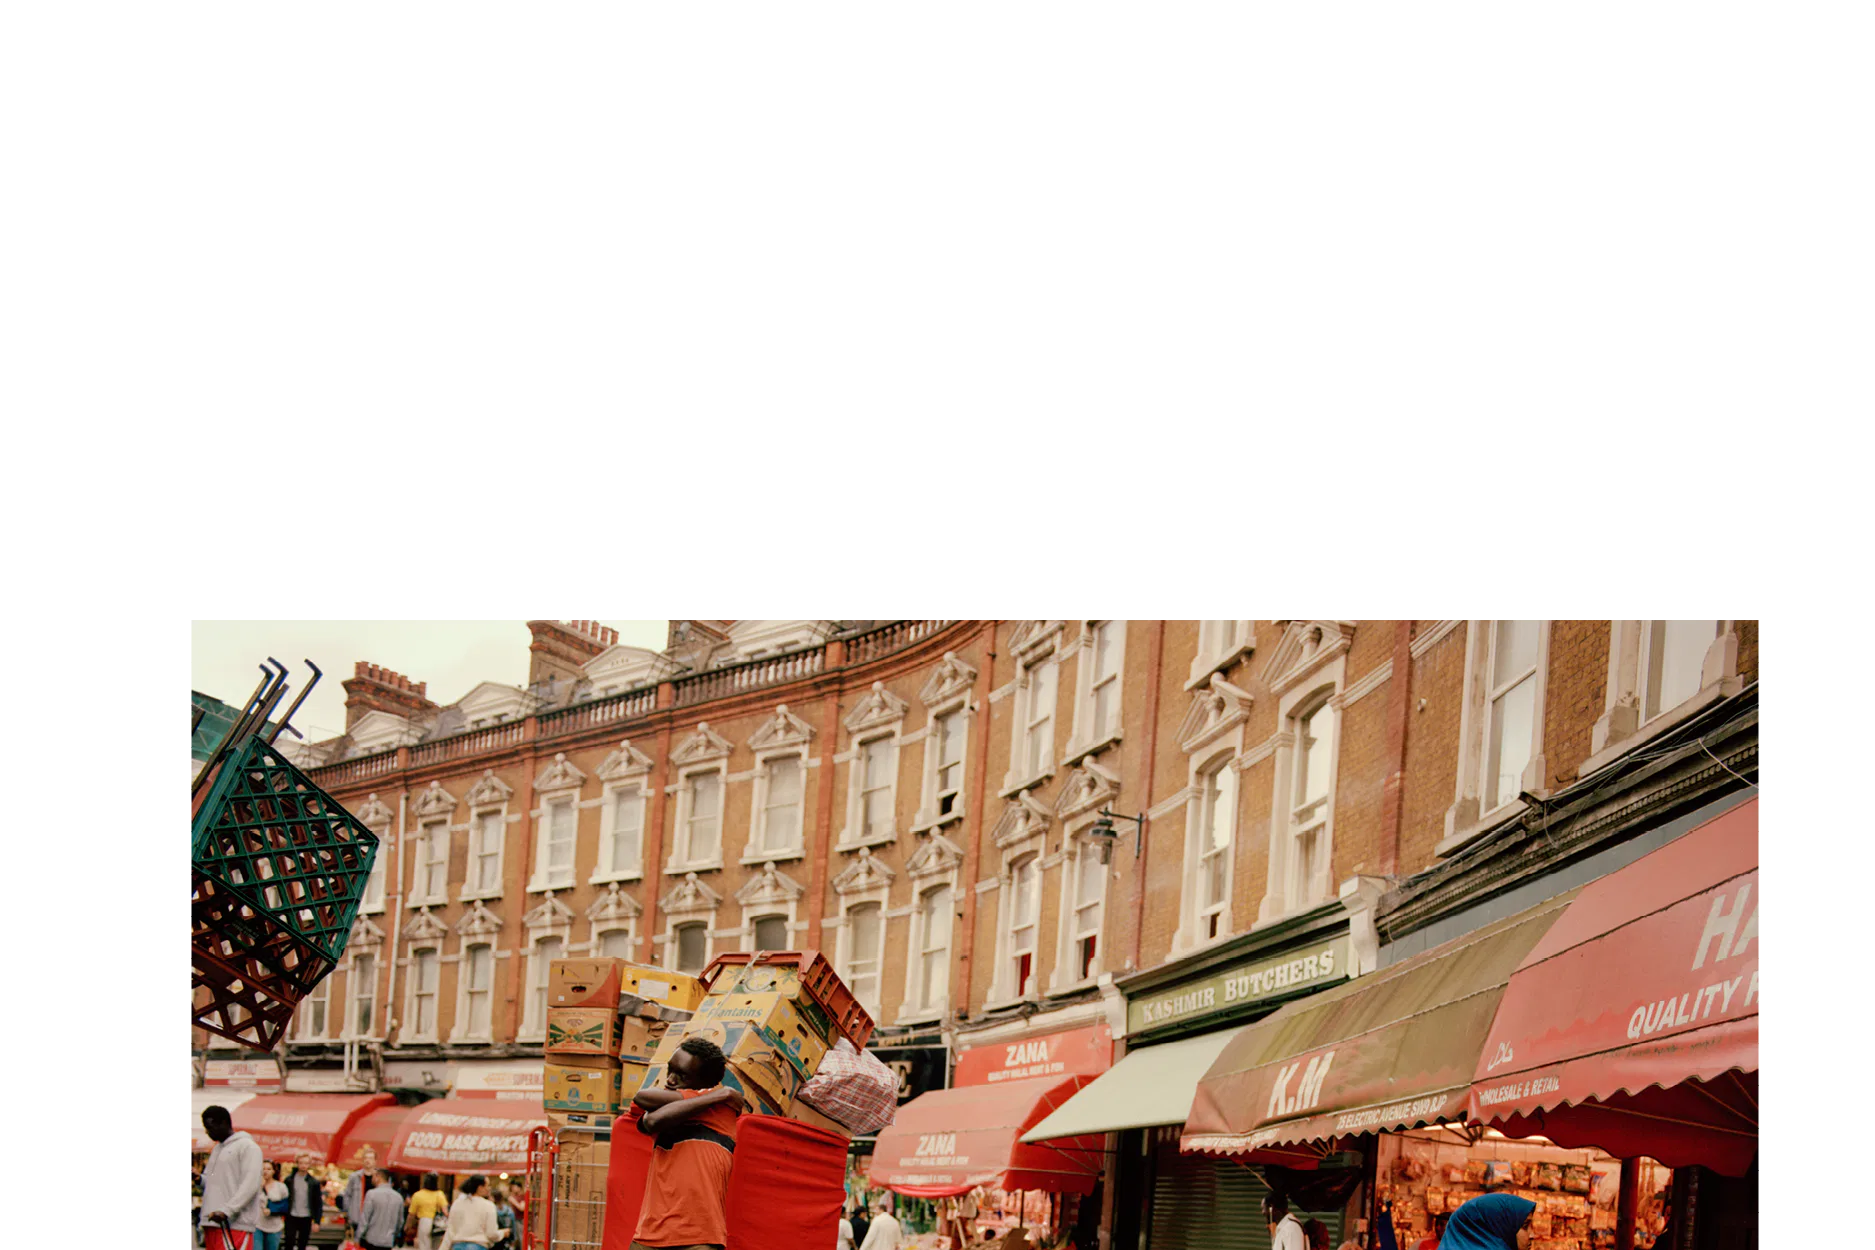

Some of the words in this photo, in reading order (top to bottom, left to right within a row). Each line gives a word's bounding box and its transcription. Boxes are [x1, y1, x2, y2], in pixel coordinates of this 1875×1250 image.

[1143, 987, 1215, 1023] KASHMIR
[1224, 950, 1334, 1002] BUTCHERS
[1627, 976, 1743, 1039] QUALITY
[1005, 1040, 1048, 1067] ZANA
[1267, 1050, 1335, 1118] K.M
[1479, 1082, 1523, 1107] WHOLESALE
[1523, 1081, 1531, 1098] &
[1531, 1077, 1559, 1096] RETAIL
[1346, 1109, 1381, 1128] ELECTRIC
[1379, 1102, 1411, 1121] AVENUE
[1411, 1098, 1430, 1117] SW9
[915, 1133, 956, 1156] ZANA
